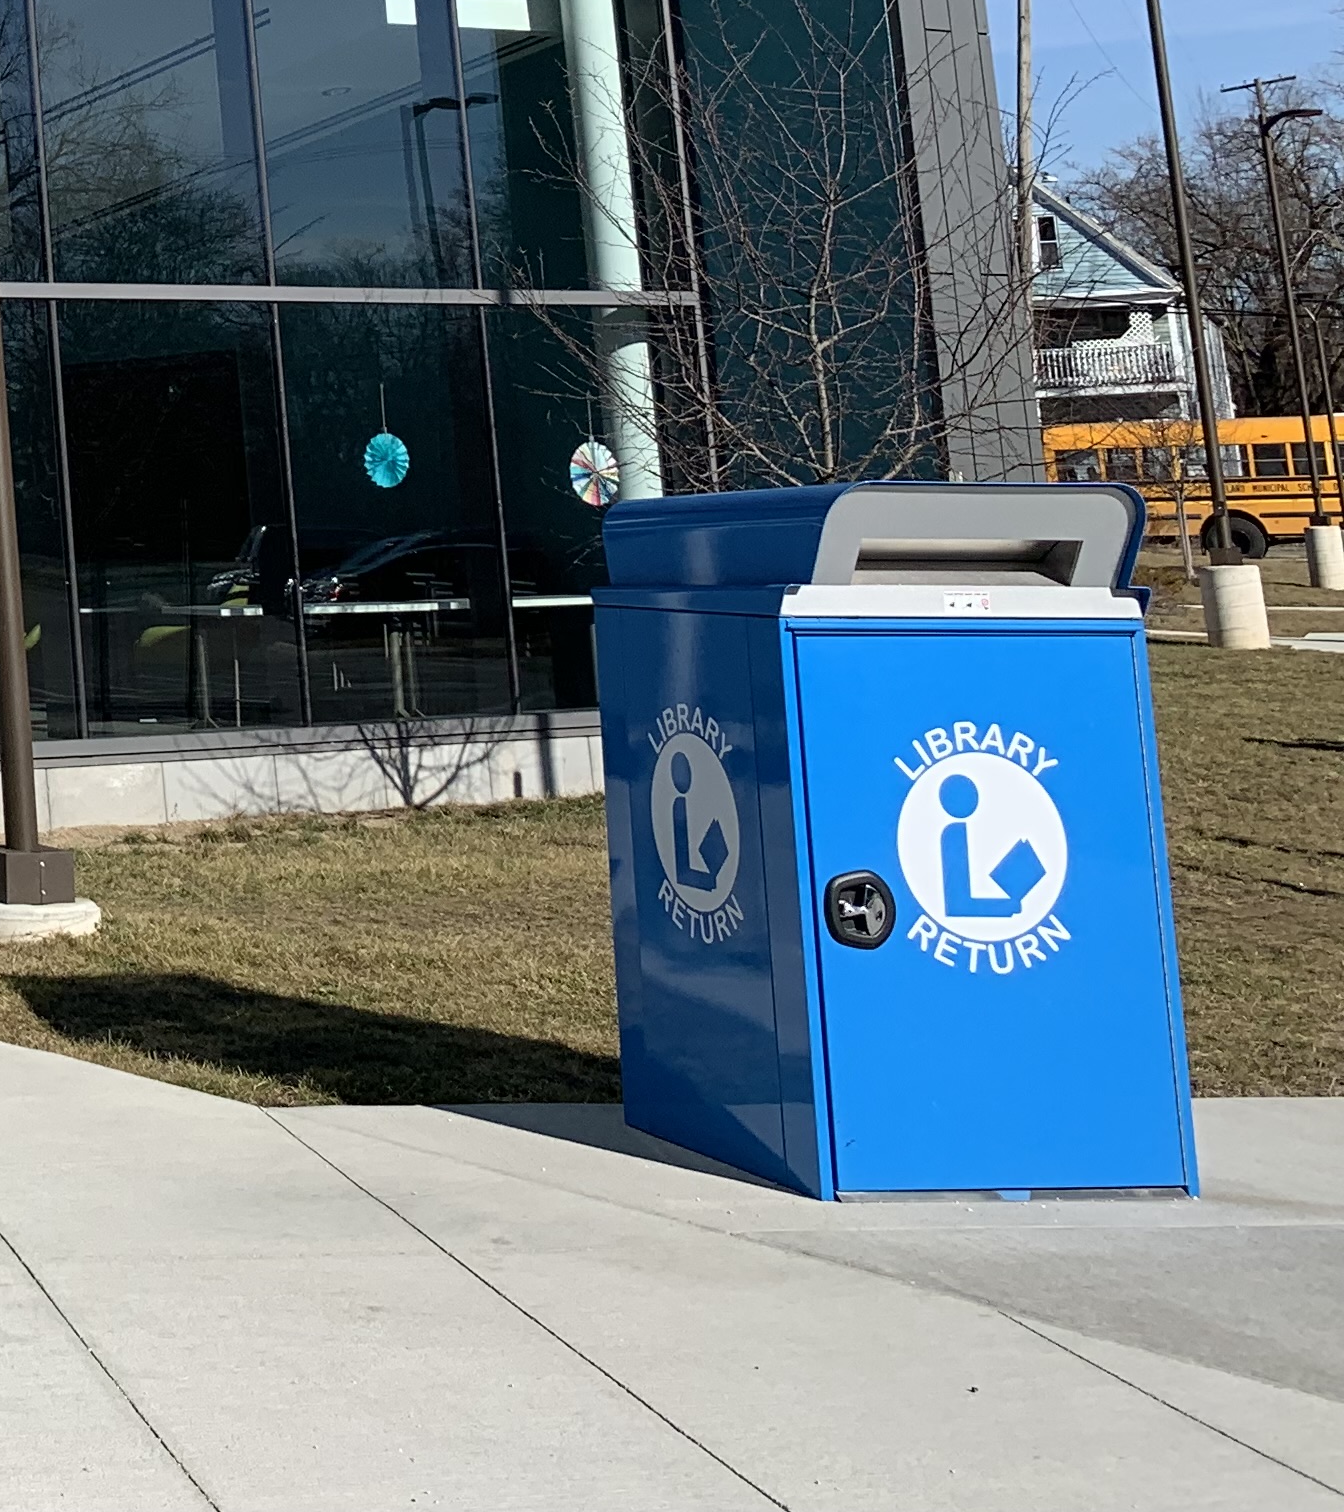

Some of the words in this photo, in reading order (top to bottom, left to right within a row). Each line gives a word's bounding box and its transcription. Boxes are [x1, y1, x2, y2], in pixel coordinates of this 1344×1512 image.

[1252, 483, 1289, 492] MUNICIPAL
[1297, 482, 1326, 492] SCHL
[648, 703, 732, 759] LIBRARY
[894, 721, 1059, 780] LIBRARY
[658, 878, 744, 944] RETURN
[907, 914, 1072, 974] RETURN
